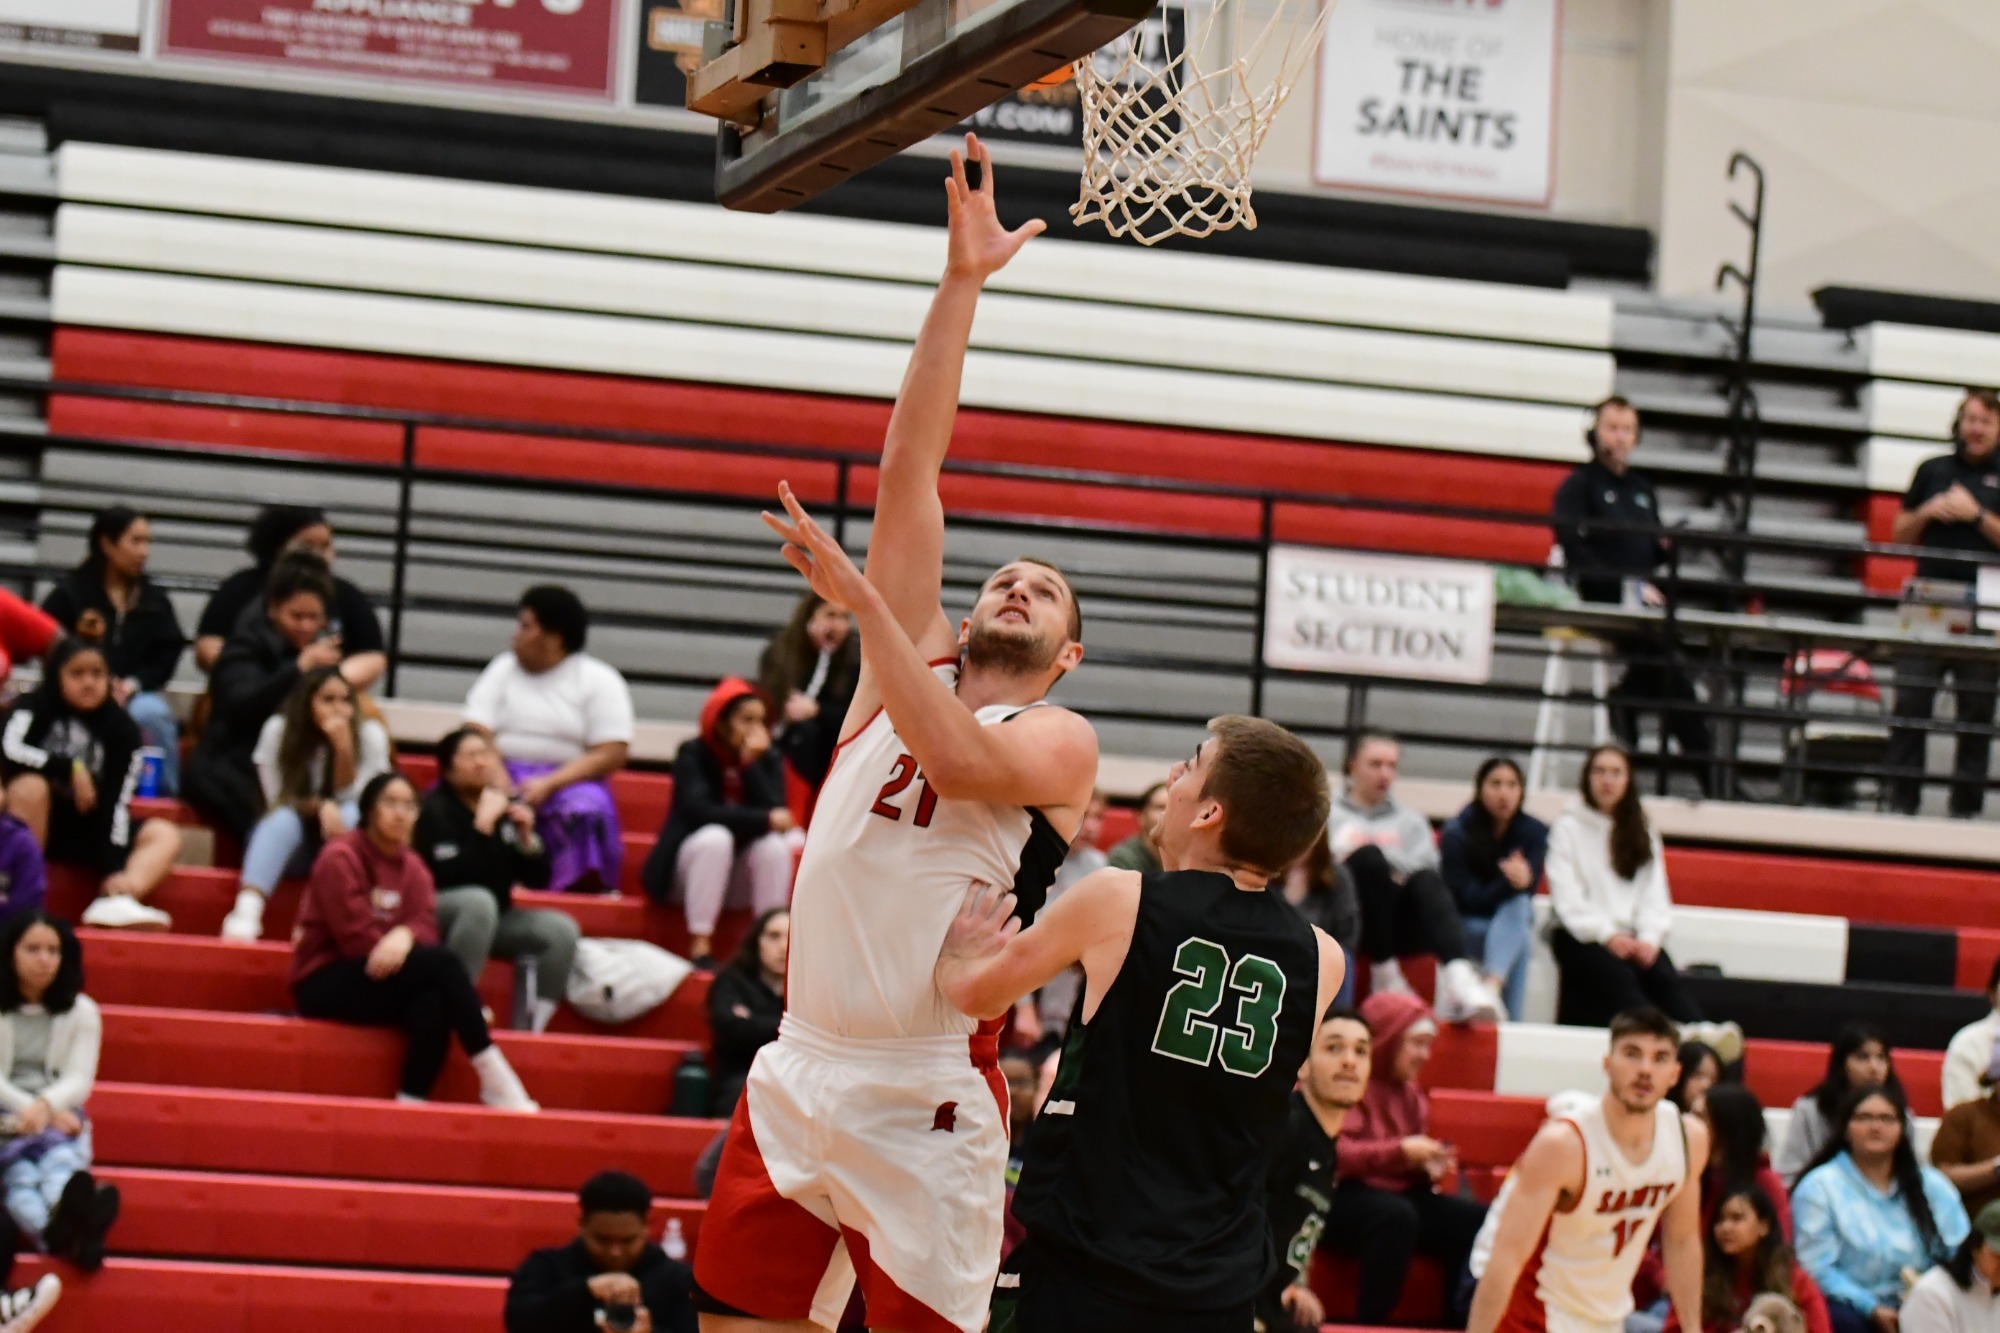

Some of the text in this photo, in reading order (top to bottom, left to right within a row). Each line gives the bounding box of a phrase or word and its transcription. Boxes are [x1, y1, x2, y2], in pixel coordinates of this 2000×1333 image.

[1397, 57, 1482, 101] THE
[1356, 96, 1517, 150] SAINTS
[1286, 566, 1473, 613] STUDENT
[1291, 615, 1464, 660] SECTION
[869, 753, 938, 828] 21
[1151, 936, 1287, 1078] 23
